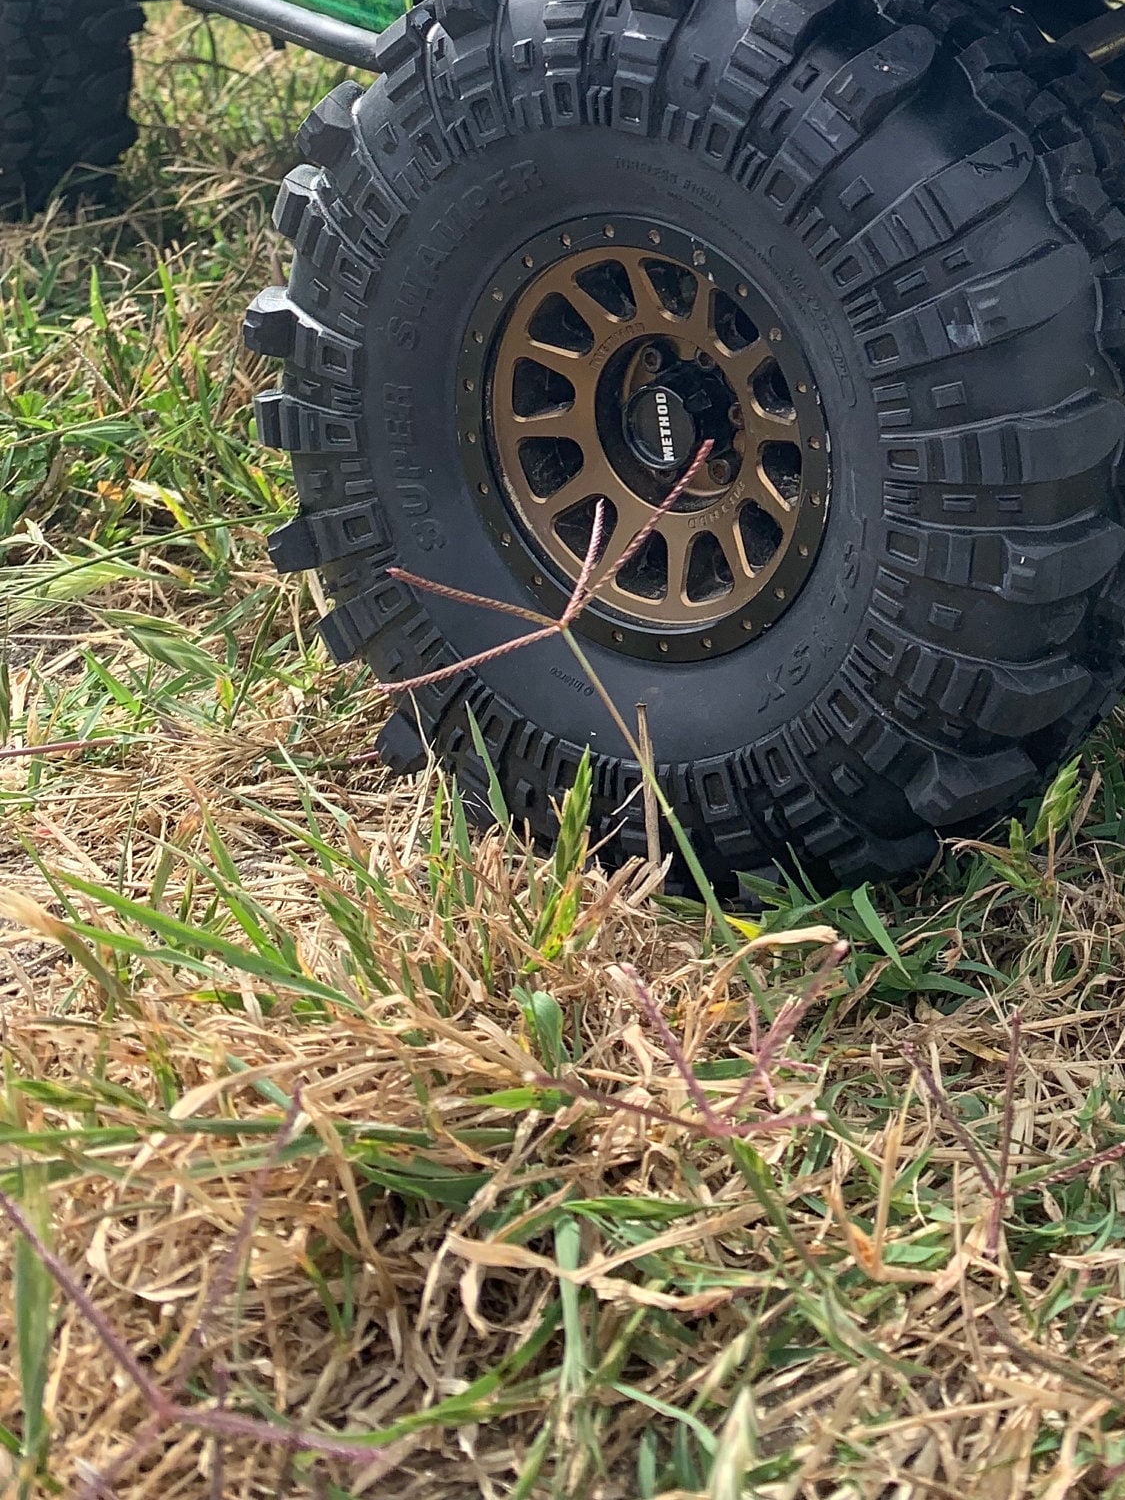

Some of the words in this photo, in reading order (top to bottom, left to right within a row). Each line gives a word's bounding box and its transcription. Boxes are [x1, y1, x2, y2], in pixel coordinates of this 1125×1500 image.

[387, 159, 545, 351] SWAMPER
[383, 381, 449, 553] SUPER
[655, 391, 676, 462] METHOD
[550, 666, 585, 693] Interco
